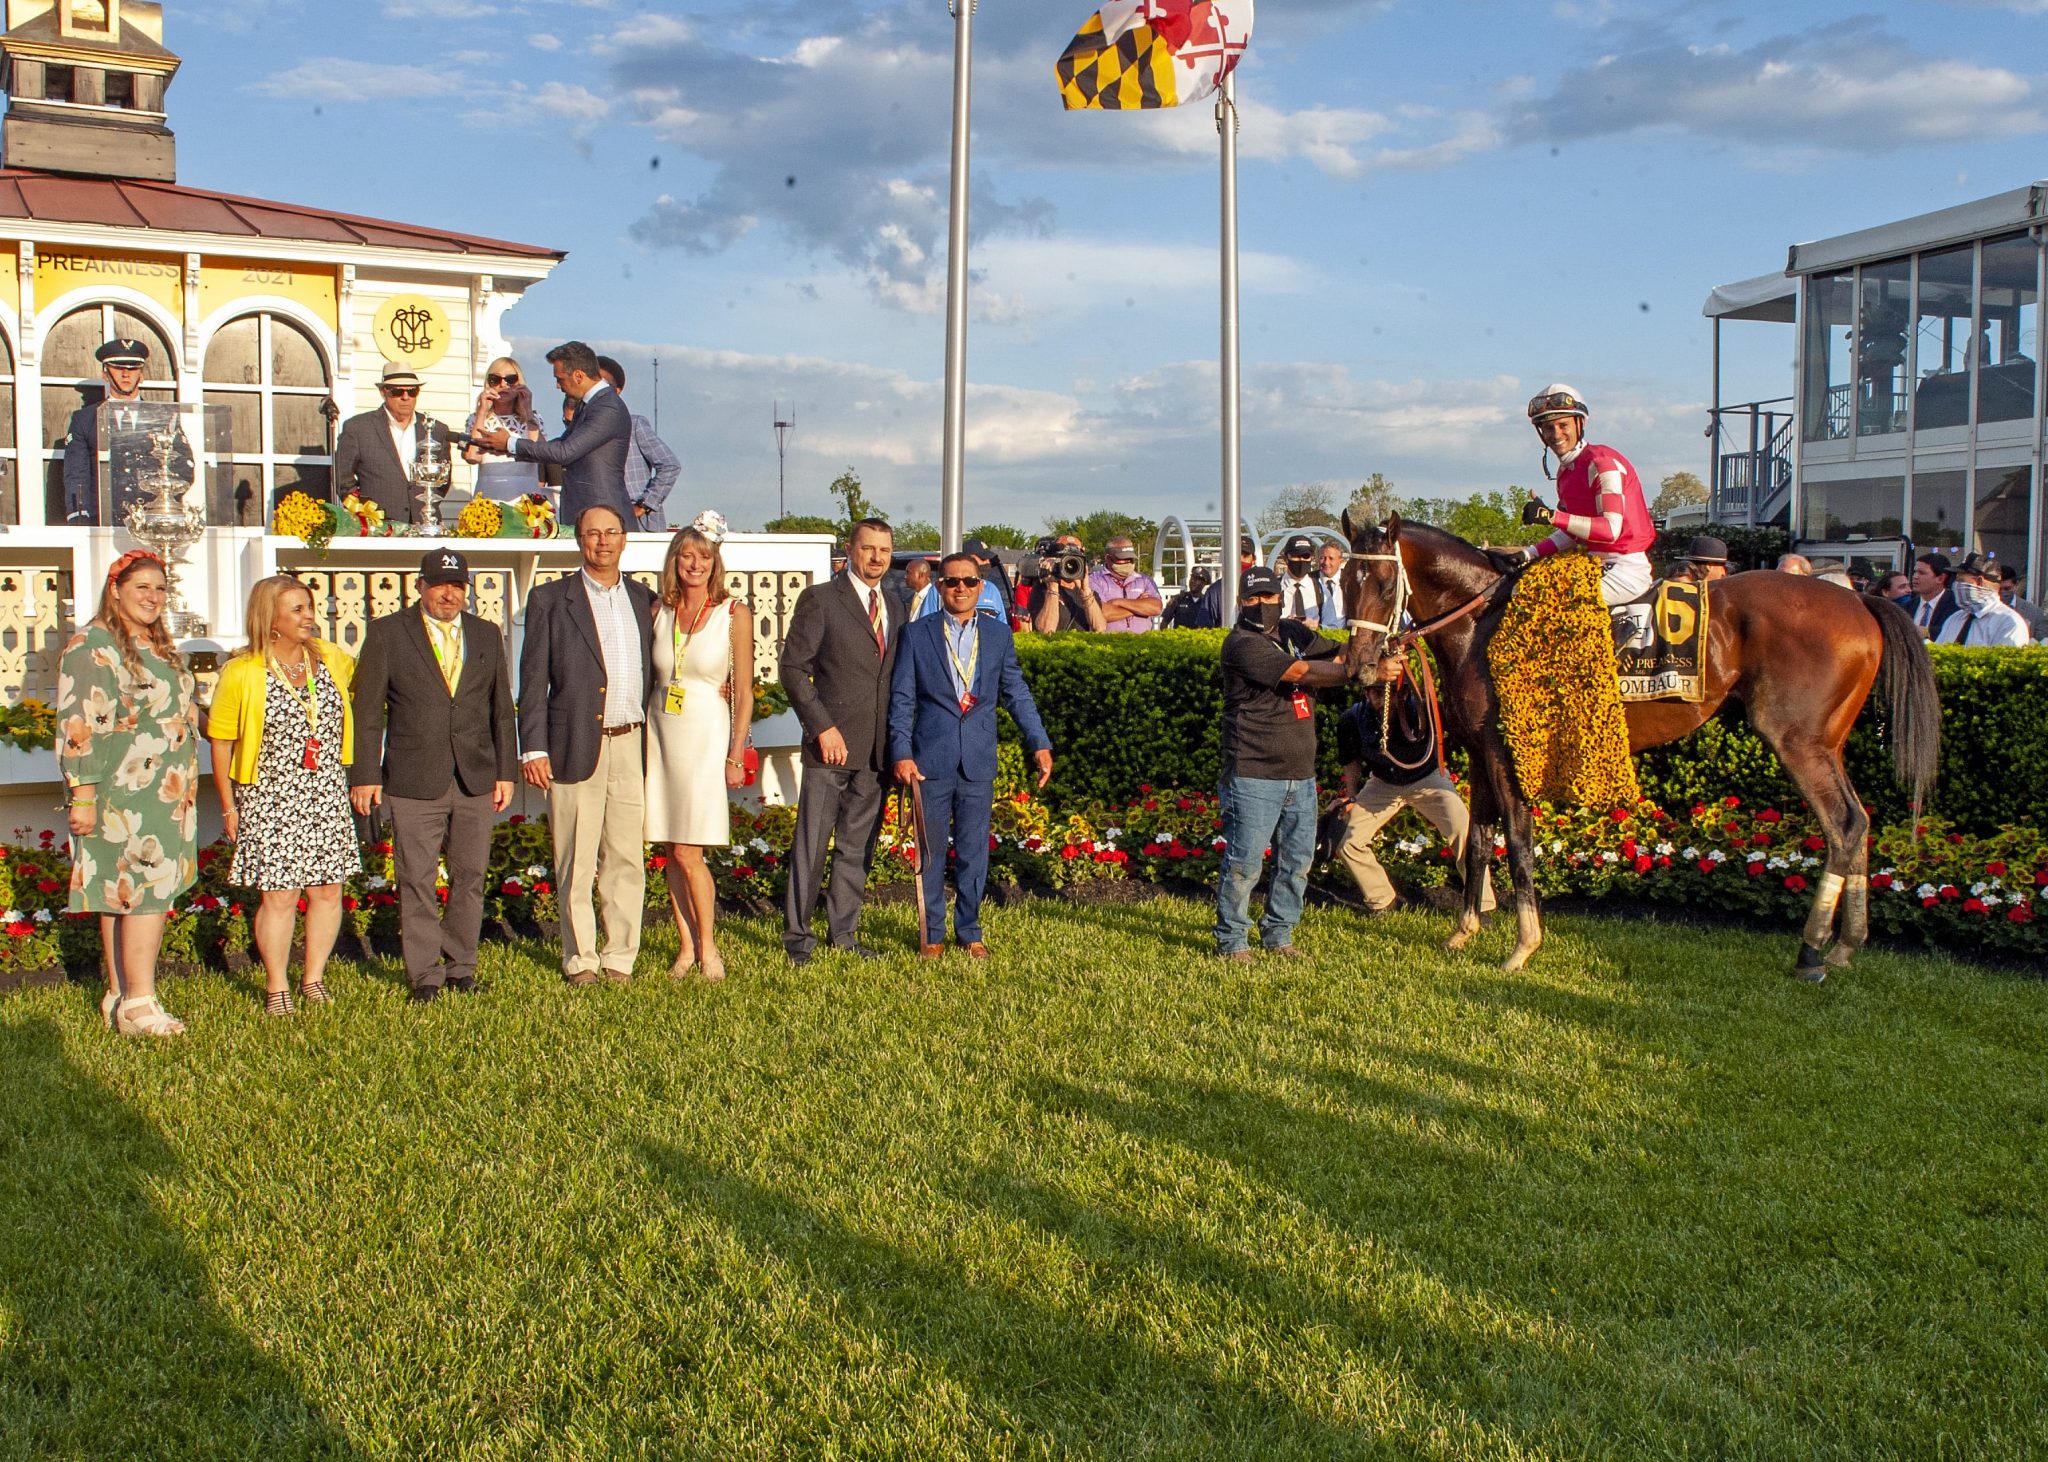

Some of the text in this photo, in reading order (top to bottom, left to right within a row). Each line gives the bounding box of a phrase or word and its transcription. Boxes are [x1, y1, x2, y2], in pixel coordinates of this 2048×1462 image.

[37, 251, 294, 286] PREAKNESS 2021
[1656, 580, 1697, 645] 6
